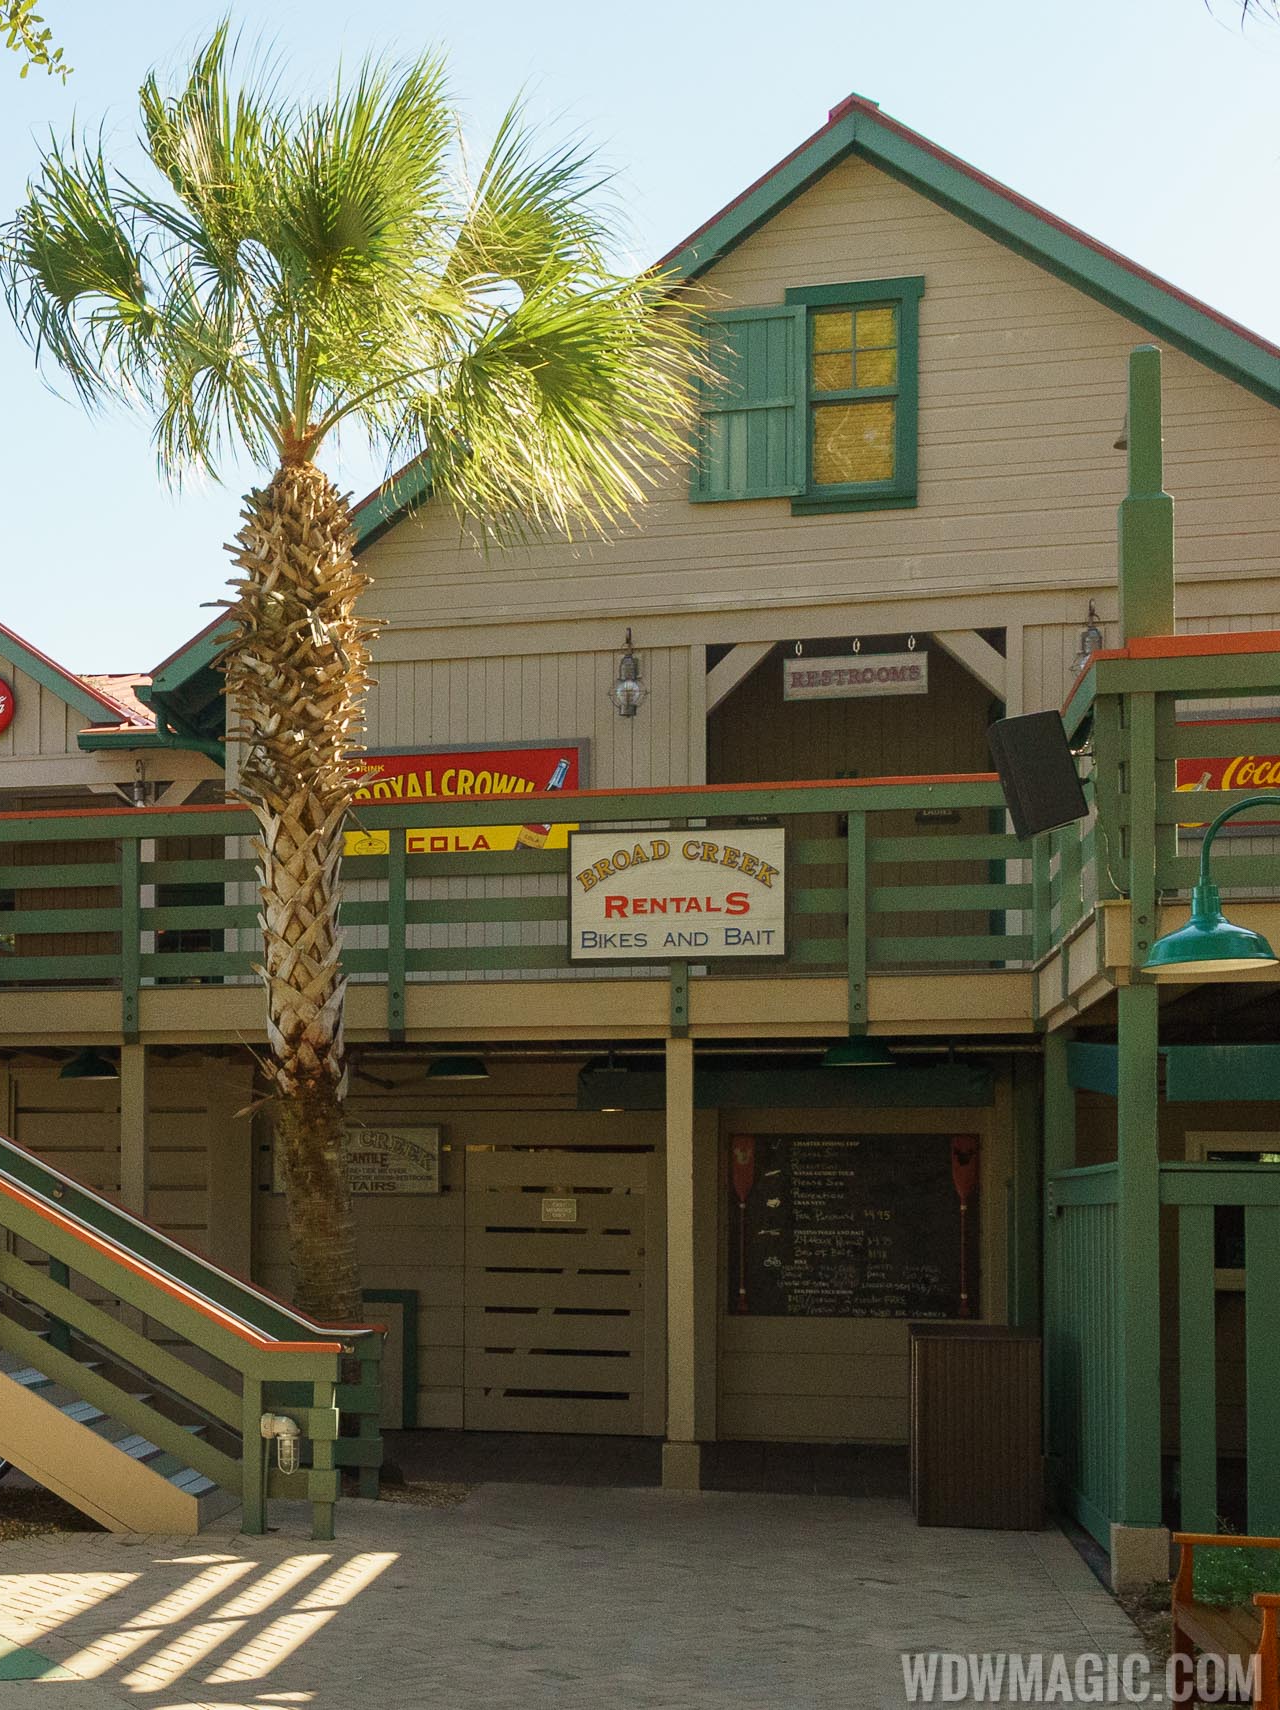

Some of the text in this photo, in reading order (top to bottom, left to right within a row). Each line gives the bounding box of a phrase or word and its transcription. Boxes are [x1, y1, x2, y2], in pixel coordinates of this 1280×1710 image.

[791, 665, 920, 688] RESTROOMS
[408, 835, 490, 852] COLA
[576, 839, 780, 892] BROAD CREEK
[604, 892, 750, 919] RENTALS
[581, 928, 775, 949] BIKES AND BAIT
[360, 1130, 436, 1171] CREEK
[350, 1182, 396, 1191] TAIRS
